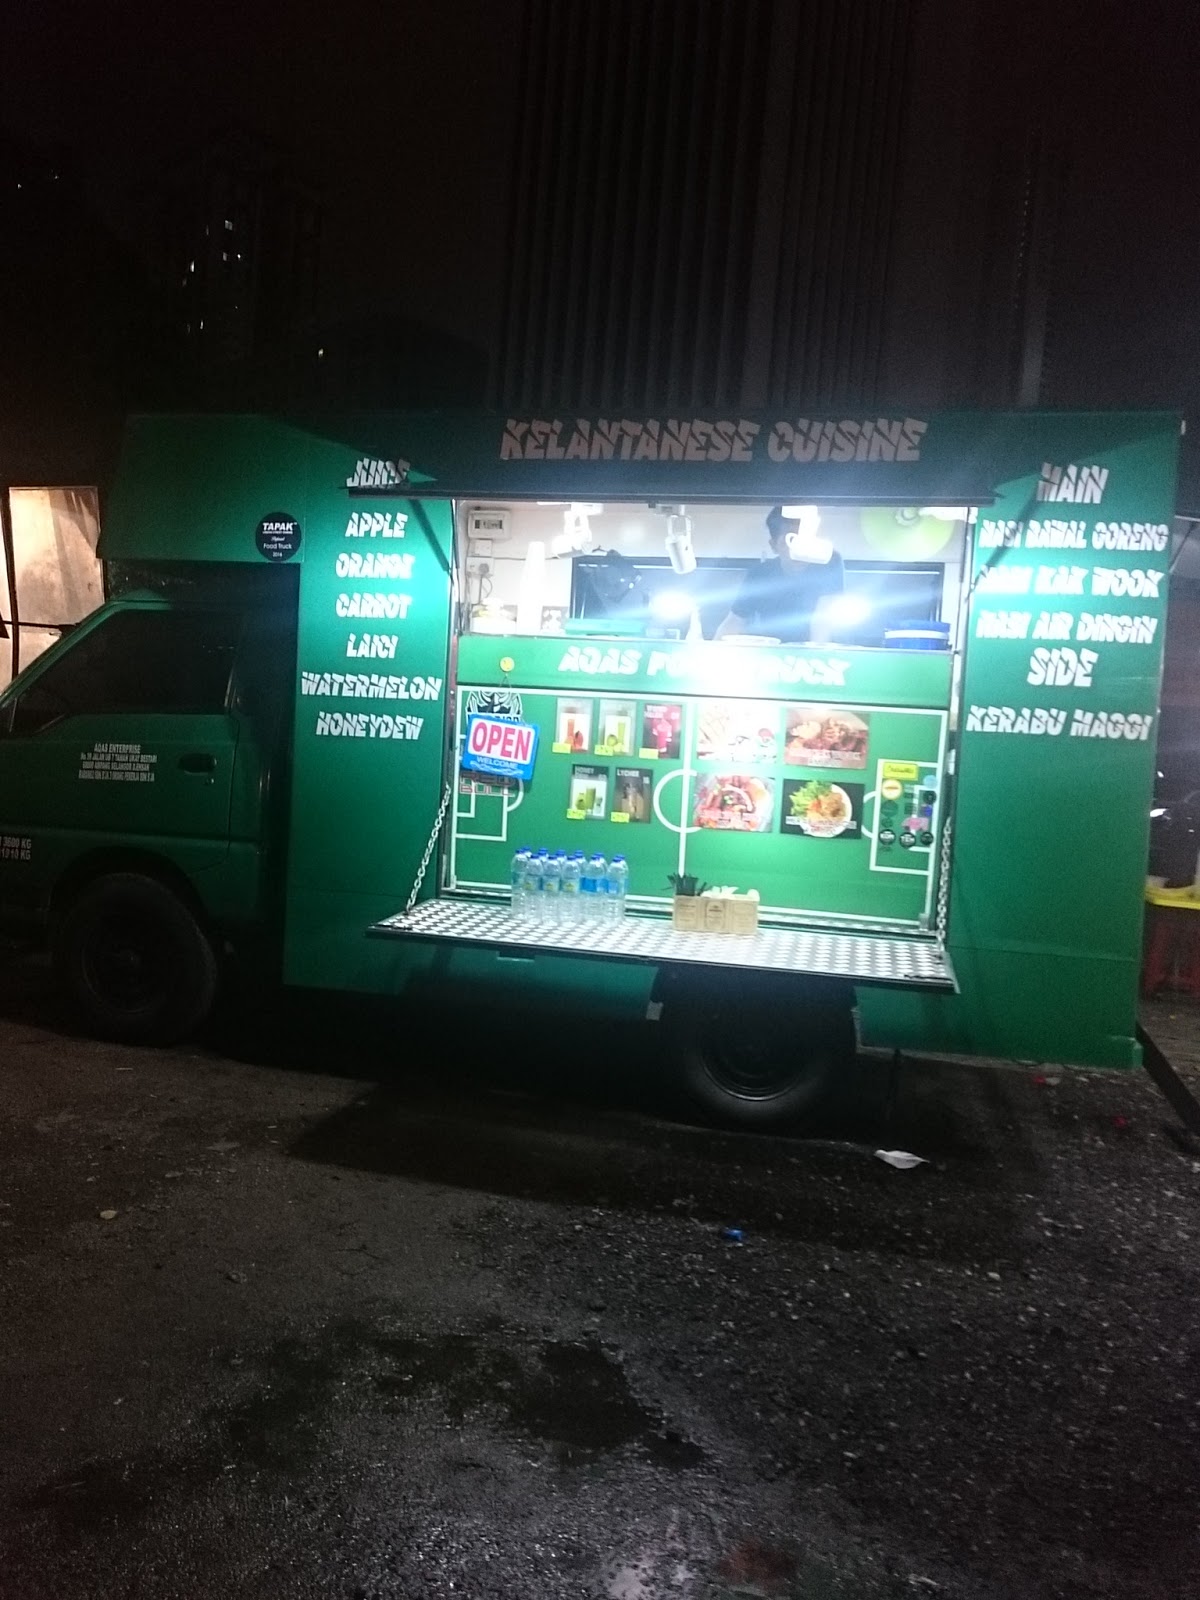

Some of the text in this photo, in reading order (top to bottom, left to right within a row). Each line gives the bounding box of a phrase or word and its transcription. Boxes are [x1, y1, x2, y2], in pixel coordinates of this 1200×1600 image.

[502, 417, 928, 462] KELANTANESE CUISINE
[1037, 462, 1109, 504] MAIN
[262, 522, 294, 531] TAPAK
[345, 512, 408, 538] APPLE
[1094, 522, 1169, 551] GORENG
[337, 552, 416, 579] ORANGE
[337, 592, 413, 619] CARROT
[1078, 612, 1158, 644] DINGIN
[1028, 647, 1099, 687] SIDE
[301, 671, 442, 700] WATERMELON
[316, 711, 424, 740] HONEYDEW
[967, 705, 1153, 741] KERABU MAGGI
[472, 721, 532, 761] OPEN
[476, 756, 519, 769] WELCOME
[21, 838, 32, 850] KG
